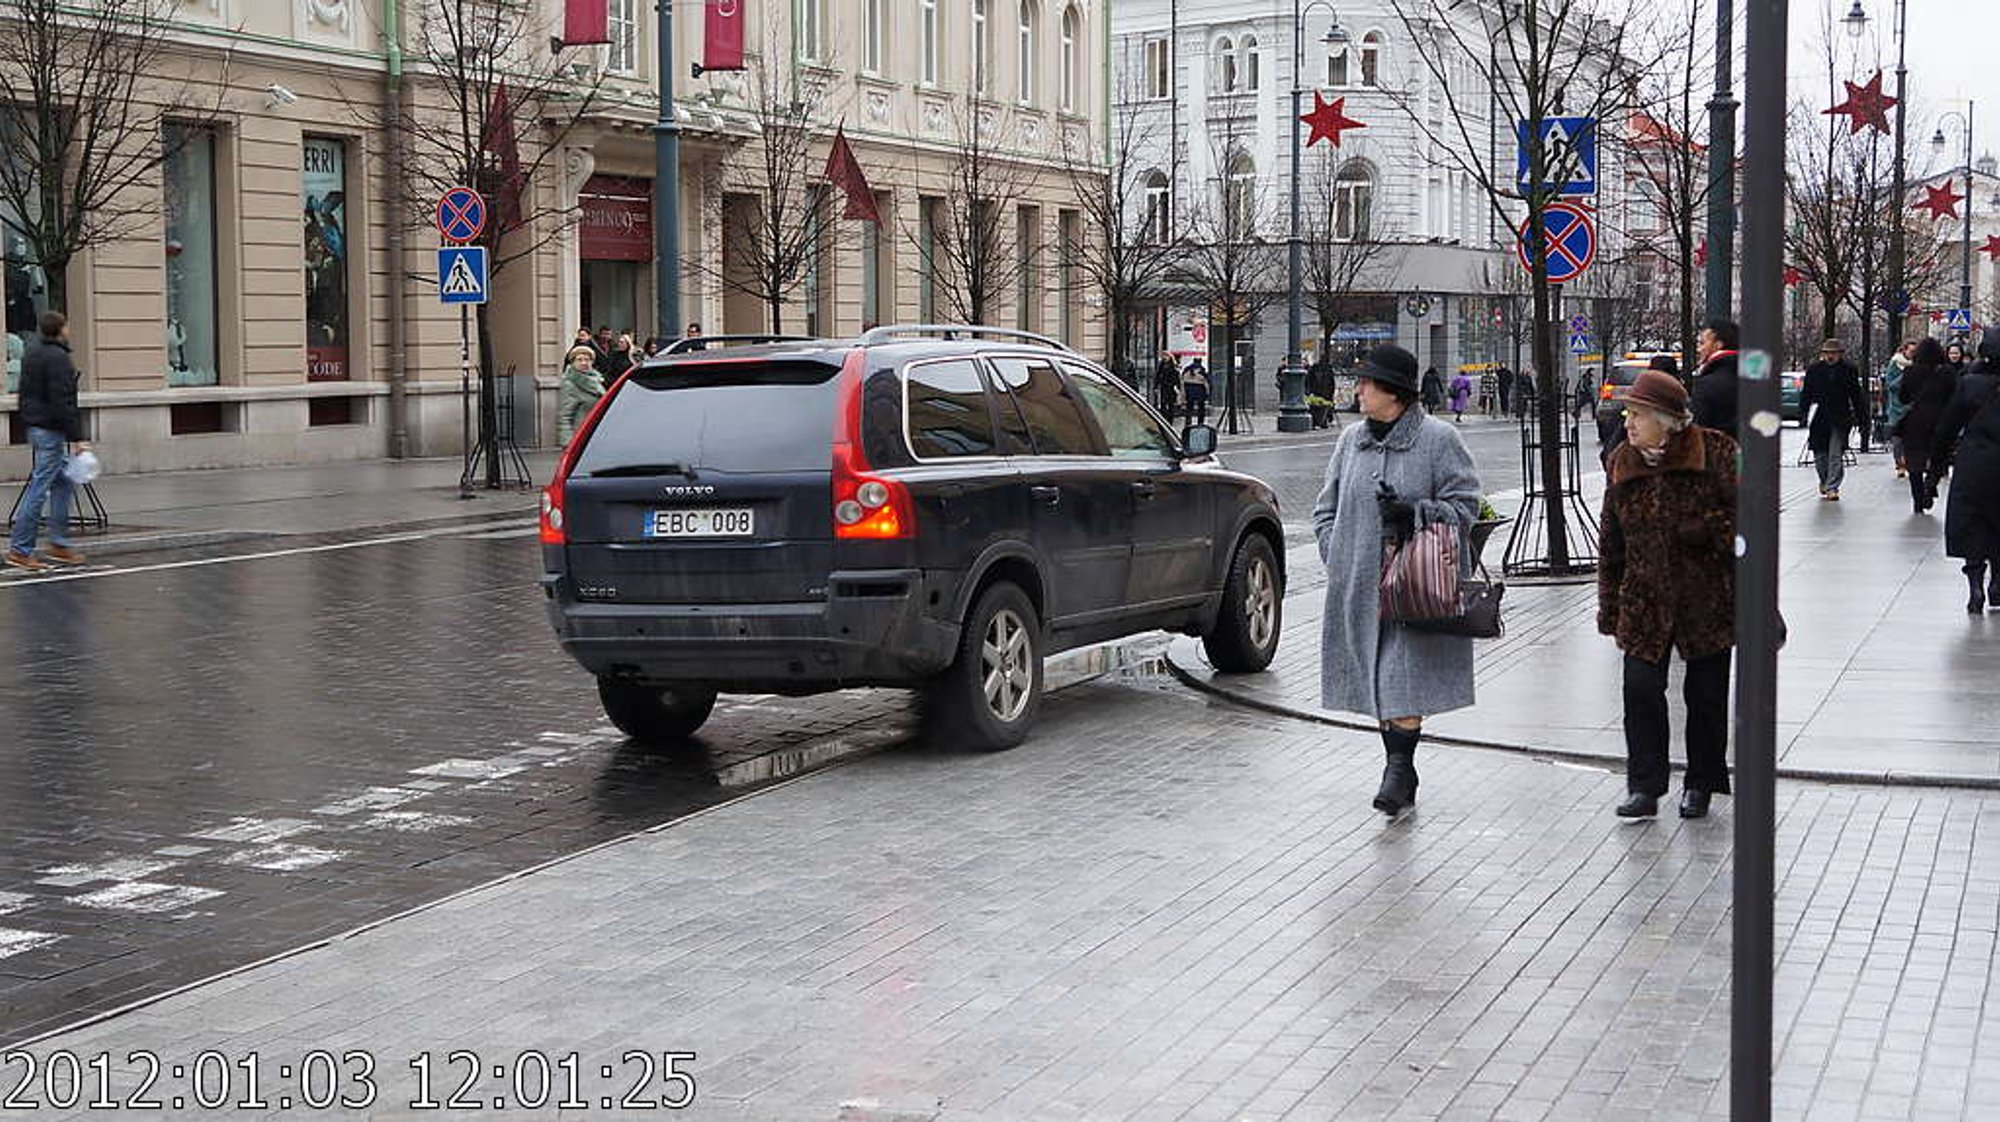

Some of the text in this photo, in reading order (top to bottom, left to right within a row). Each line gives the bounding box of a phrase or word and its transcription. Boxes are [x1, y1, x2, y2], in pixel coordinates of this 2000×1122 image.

[664, 485, 715, 496] VOLVO
[656, 511, 750, 534] EBC 008
